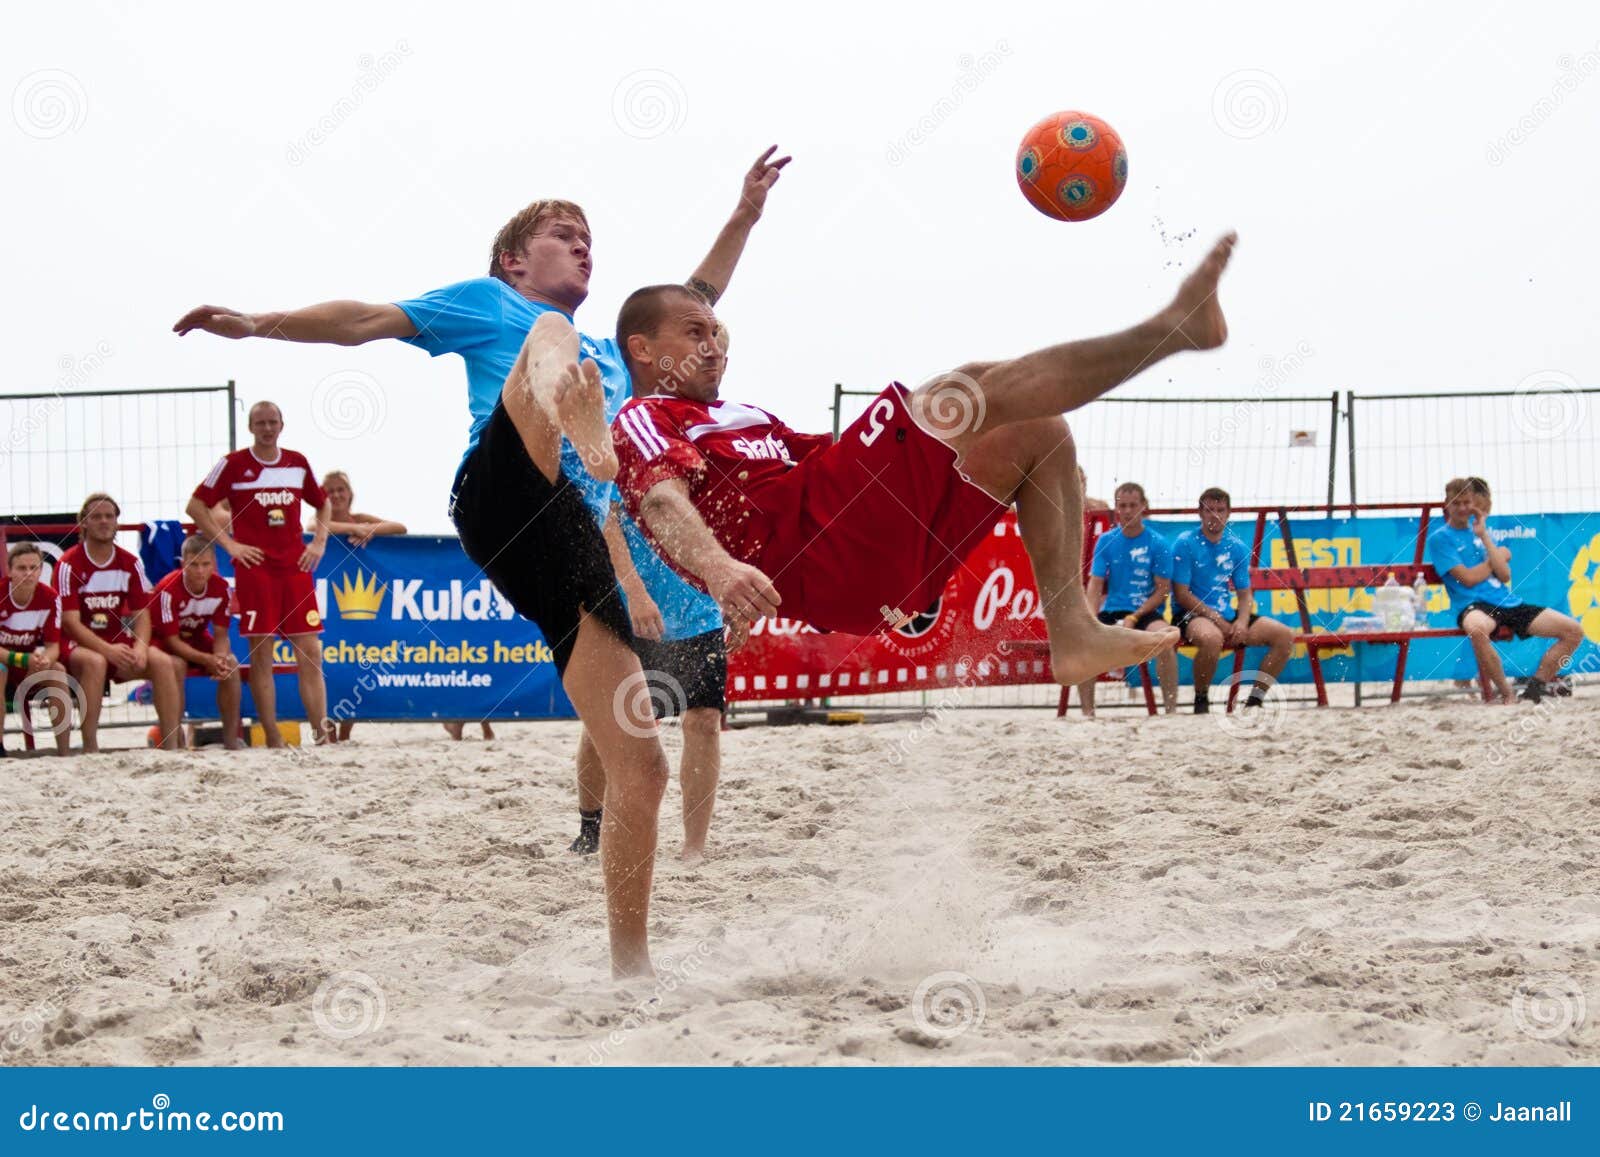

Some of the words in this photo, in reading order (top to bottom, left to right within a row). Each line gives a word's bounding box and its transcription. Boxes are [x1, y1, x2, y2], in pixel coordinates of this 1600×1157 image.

[859, 398, 895, 447] 5
[246, 610, 257, 631] 7
[402, 640, 488, 663] rahaks
[376, 670, 492, 687] www.tavid.ee
